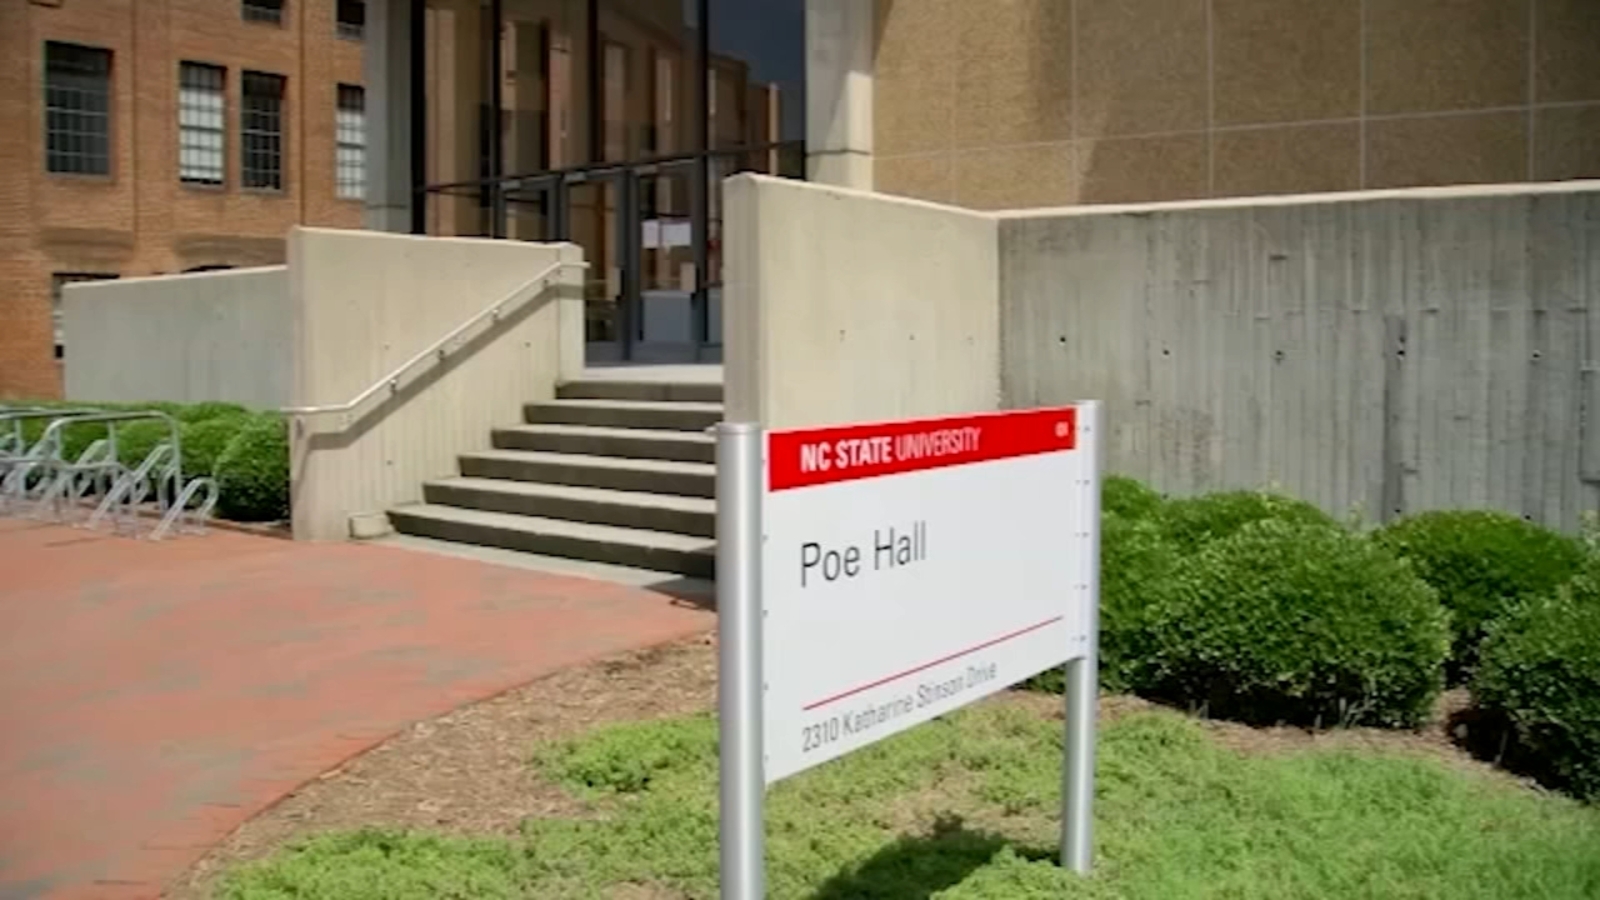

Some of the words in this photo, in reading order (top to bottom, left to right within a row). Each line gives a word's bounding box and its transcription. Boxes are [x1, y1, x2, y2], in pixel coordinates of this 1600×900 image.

[800, 442, 832, 473] NC
[835, 436, 892, 469] STATE
[894, 427, 981, 461] UNIVERSITY
[801, 542, 860, 588] Poe
[874, 520, 926, 570] Hall
[802, 717, 839, 753] 2310
[966, 662, 997, 689] Drive
